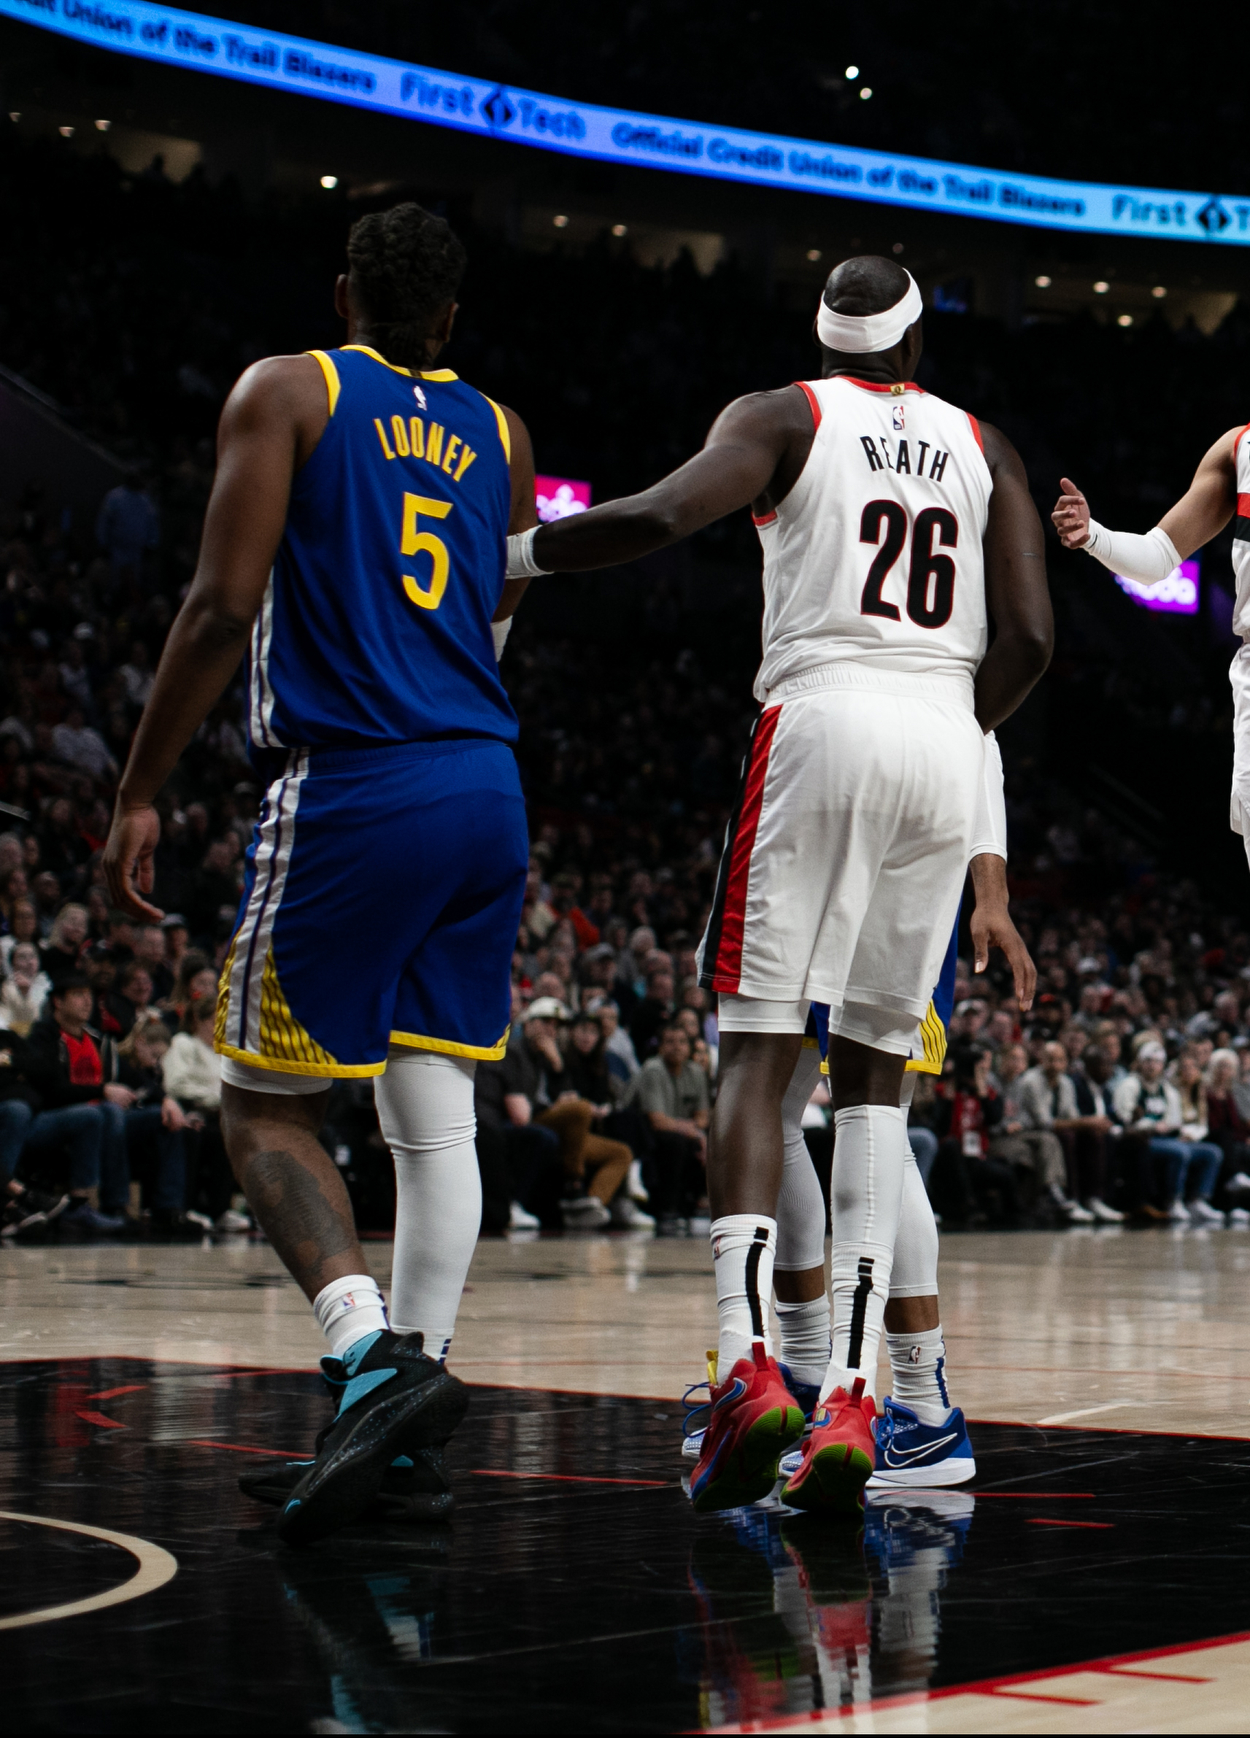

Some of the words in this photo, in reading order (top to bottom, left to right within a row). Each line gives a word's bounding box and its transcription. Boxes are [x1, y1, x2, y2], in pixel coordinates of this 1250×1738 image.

[139, 18, 171, 50] of
[172, 23, 219, 59] the
[221, 33, 280, 71] Trail
[282, 47, 377, 94] Blazers
[401, 72, 474, 117] First
[518, 97, 586, 140] Tech
[611, 122, 703, 159] Official
[707, 137, 784, 171] Credit
[788, 150, 863, 183] Union
[866, 165, 894, 187] of
[896, 169, 938, 196] the
[941, 174, 996, 205] Trail
[997, 182, 1086, 217] Blazers
[1111, 193, 1186, 227] First
[374, 415, 477, 482] LOONEY
[860, 435, 949, 482] REATH
[400, 491, 453, 610] 5
[859, 498, 958, 629] 26
